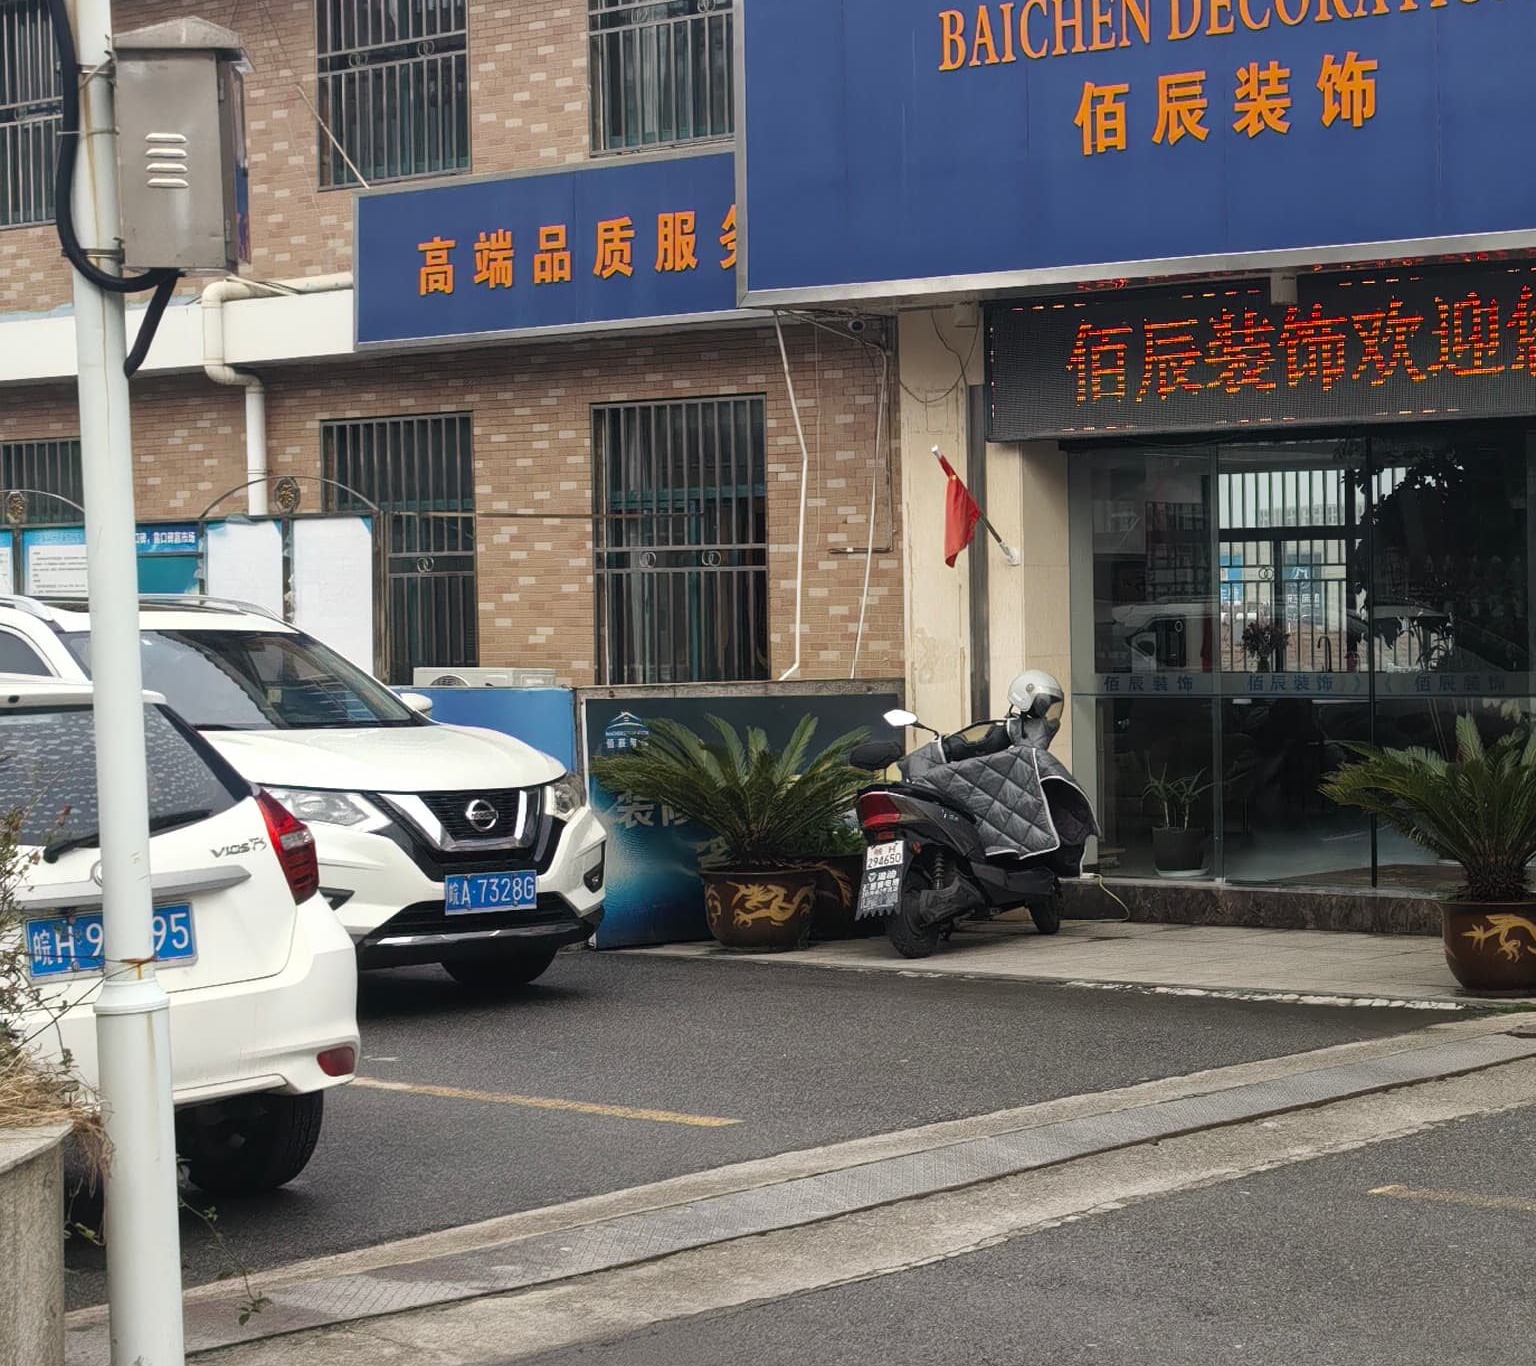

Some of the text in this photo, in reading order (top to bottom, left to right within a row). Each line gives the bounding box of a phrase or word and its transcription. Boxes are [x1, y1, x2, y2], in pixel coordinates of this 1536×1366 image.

[1074, 51, 1380, 156] 佰辰装饰
[1103, 675, 1194, 692] 佰辰装饰
[1247, 674, 1333, 692] 佰辰装饰
[32, 912, 189, 966] 皖H995
